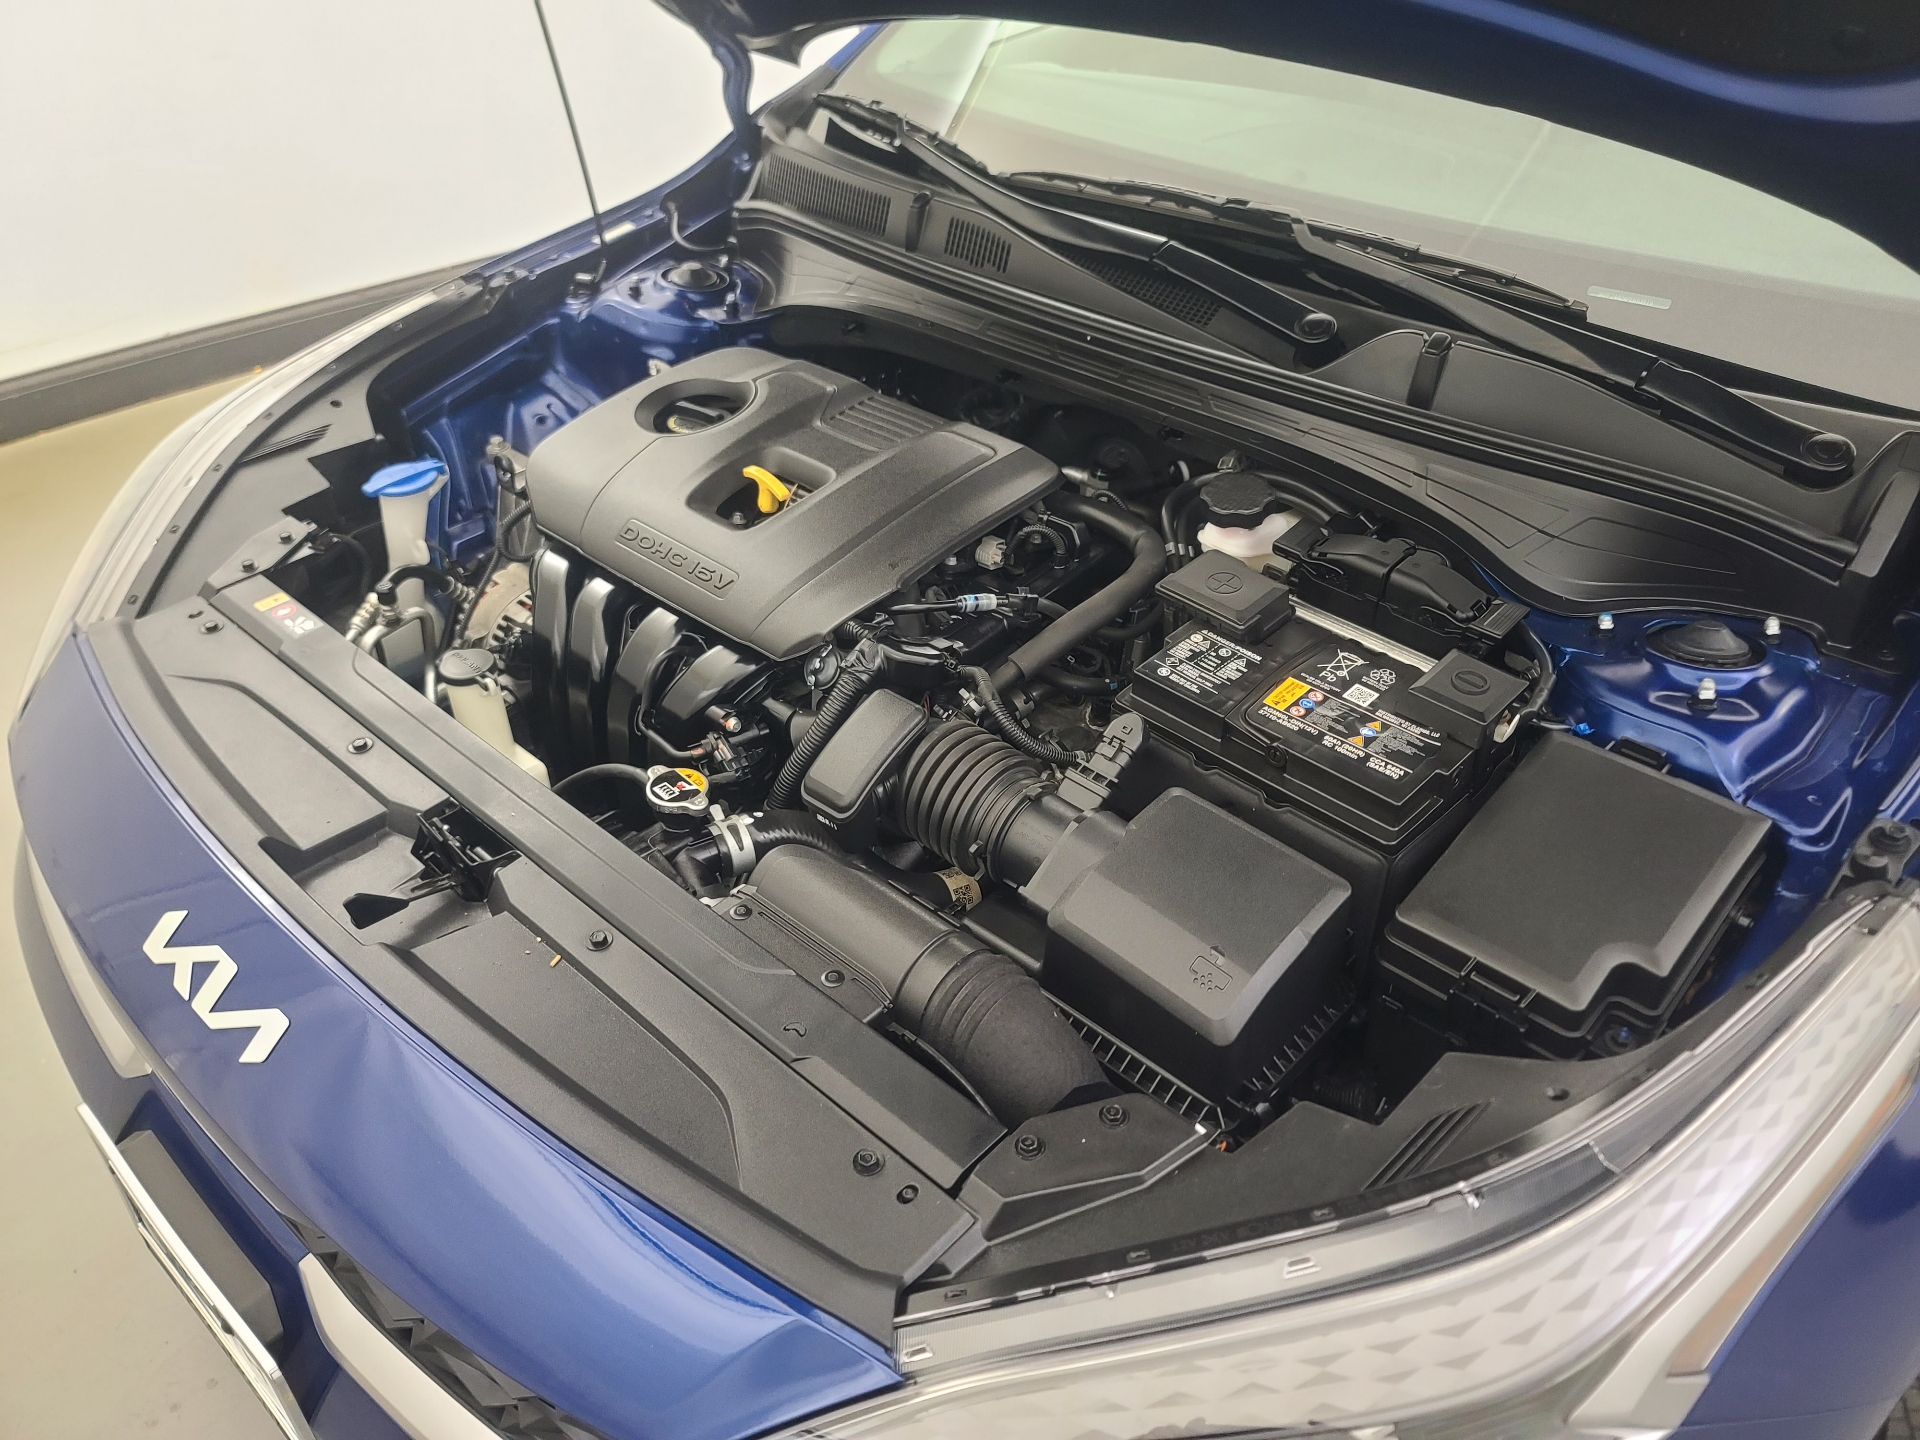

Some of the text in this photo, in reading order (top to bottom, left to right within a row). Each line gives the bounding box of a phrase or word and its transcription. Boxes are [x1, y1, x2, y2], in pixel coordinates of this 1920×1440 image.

[619, 527, 735, 591] DOHC 16V
[1319, 670, 1338, 683] Pb
[1321, 739, 1359, 760] RC 100min
[1369, 756, 1387, 769] CCA
[142, 909, 290, 1064] KIA
